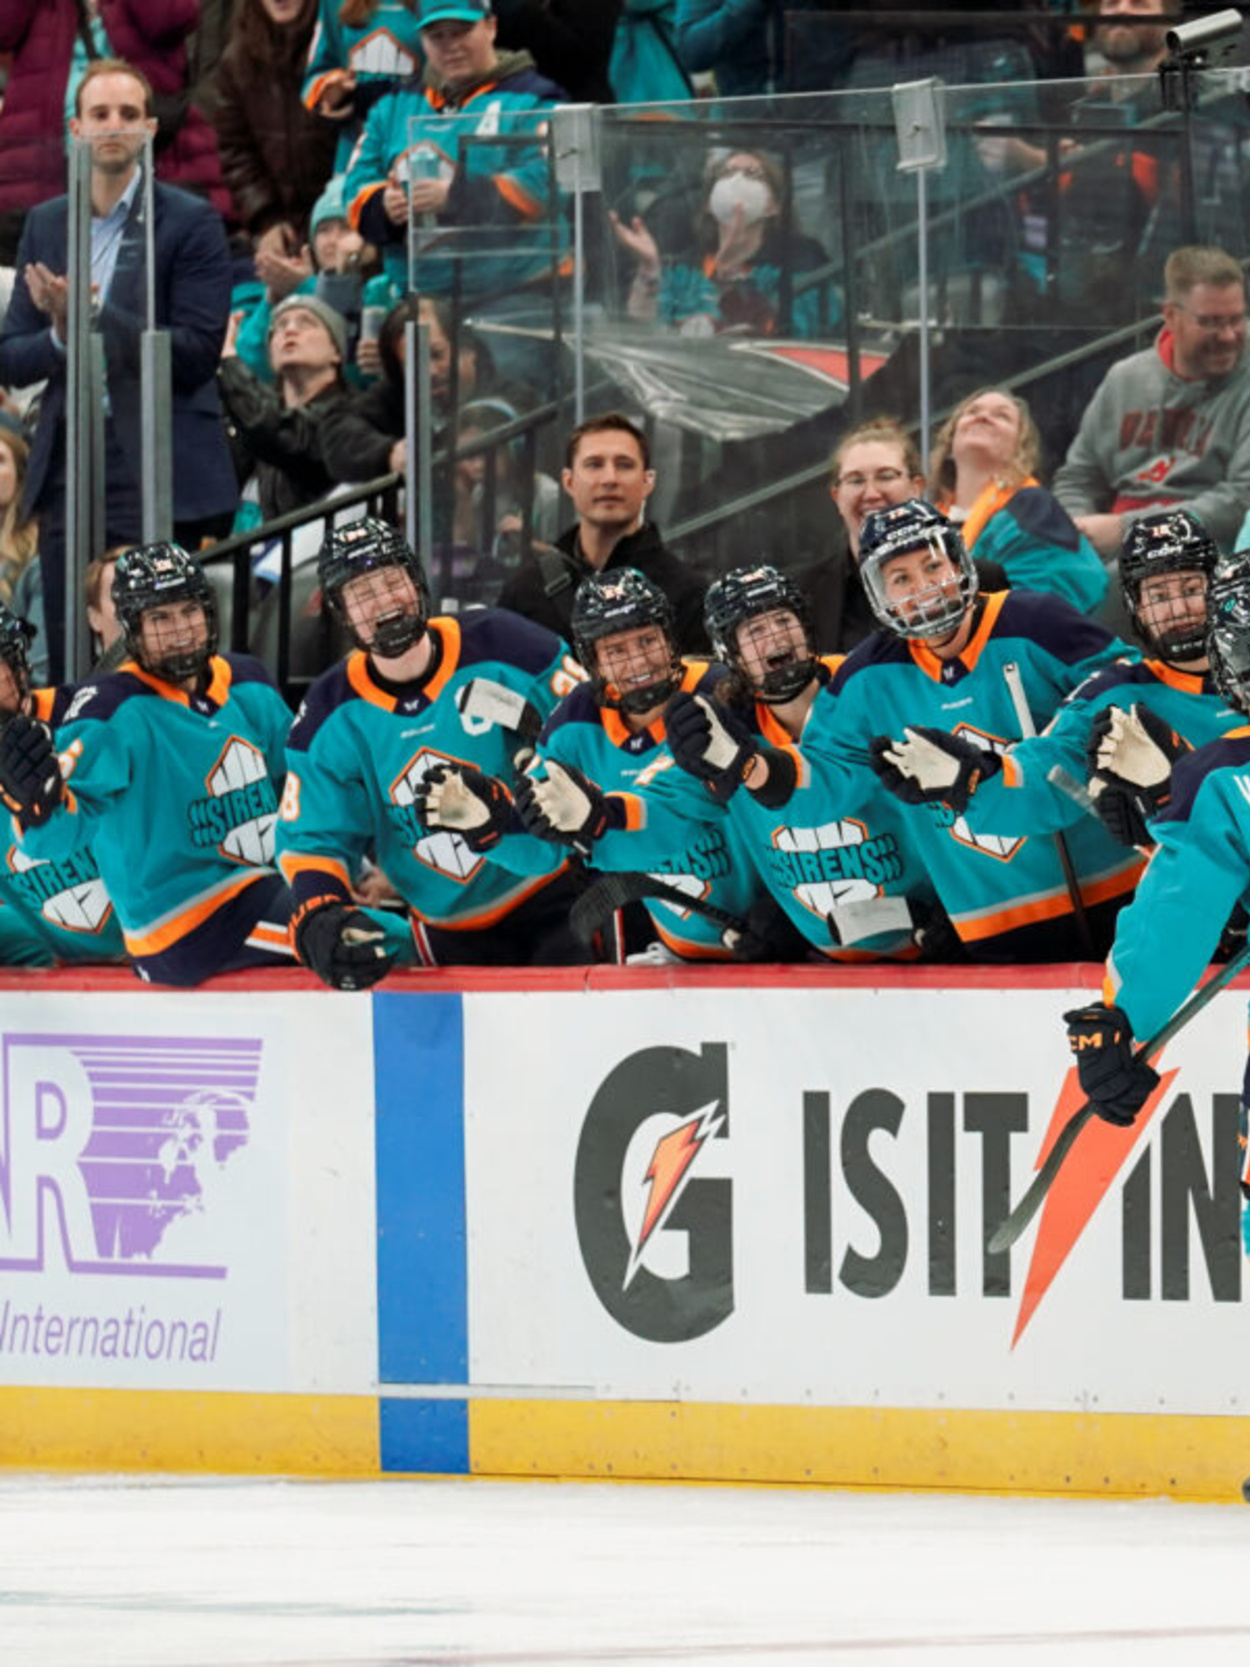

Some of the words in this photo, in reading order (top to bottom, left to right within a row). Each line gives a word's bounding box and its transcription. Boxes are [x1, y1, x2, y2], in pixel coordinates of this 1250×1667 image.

[209, 777, 280, 844] SIREN
[18, 847, 101, 912] SIREN
[776, 838, 885, 889] SIRENS
[573, 1041, 735, 1344] G
[0, 1298, 223, 1363] International
